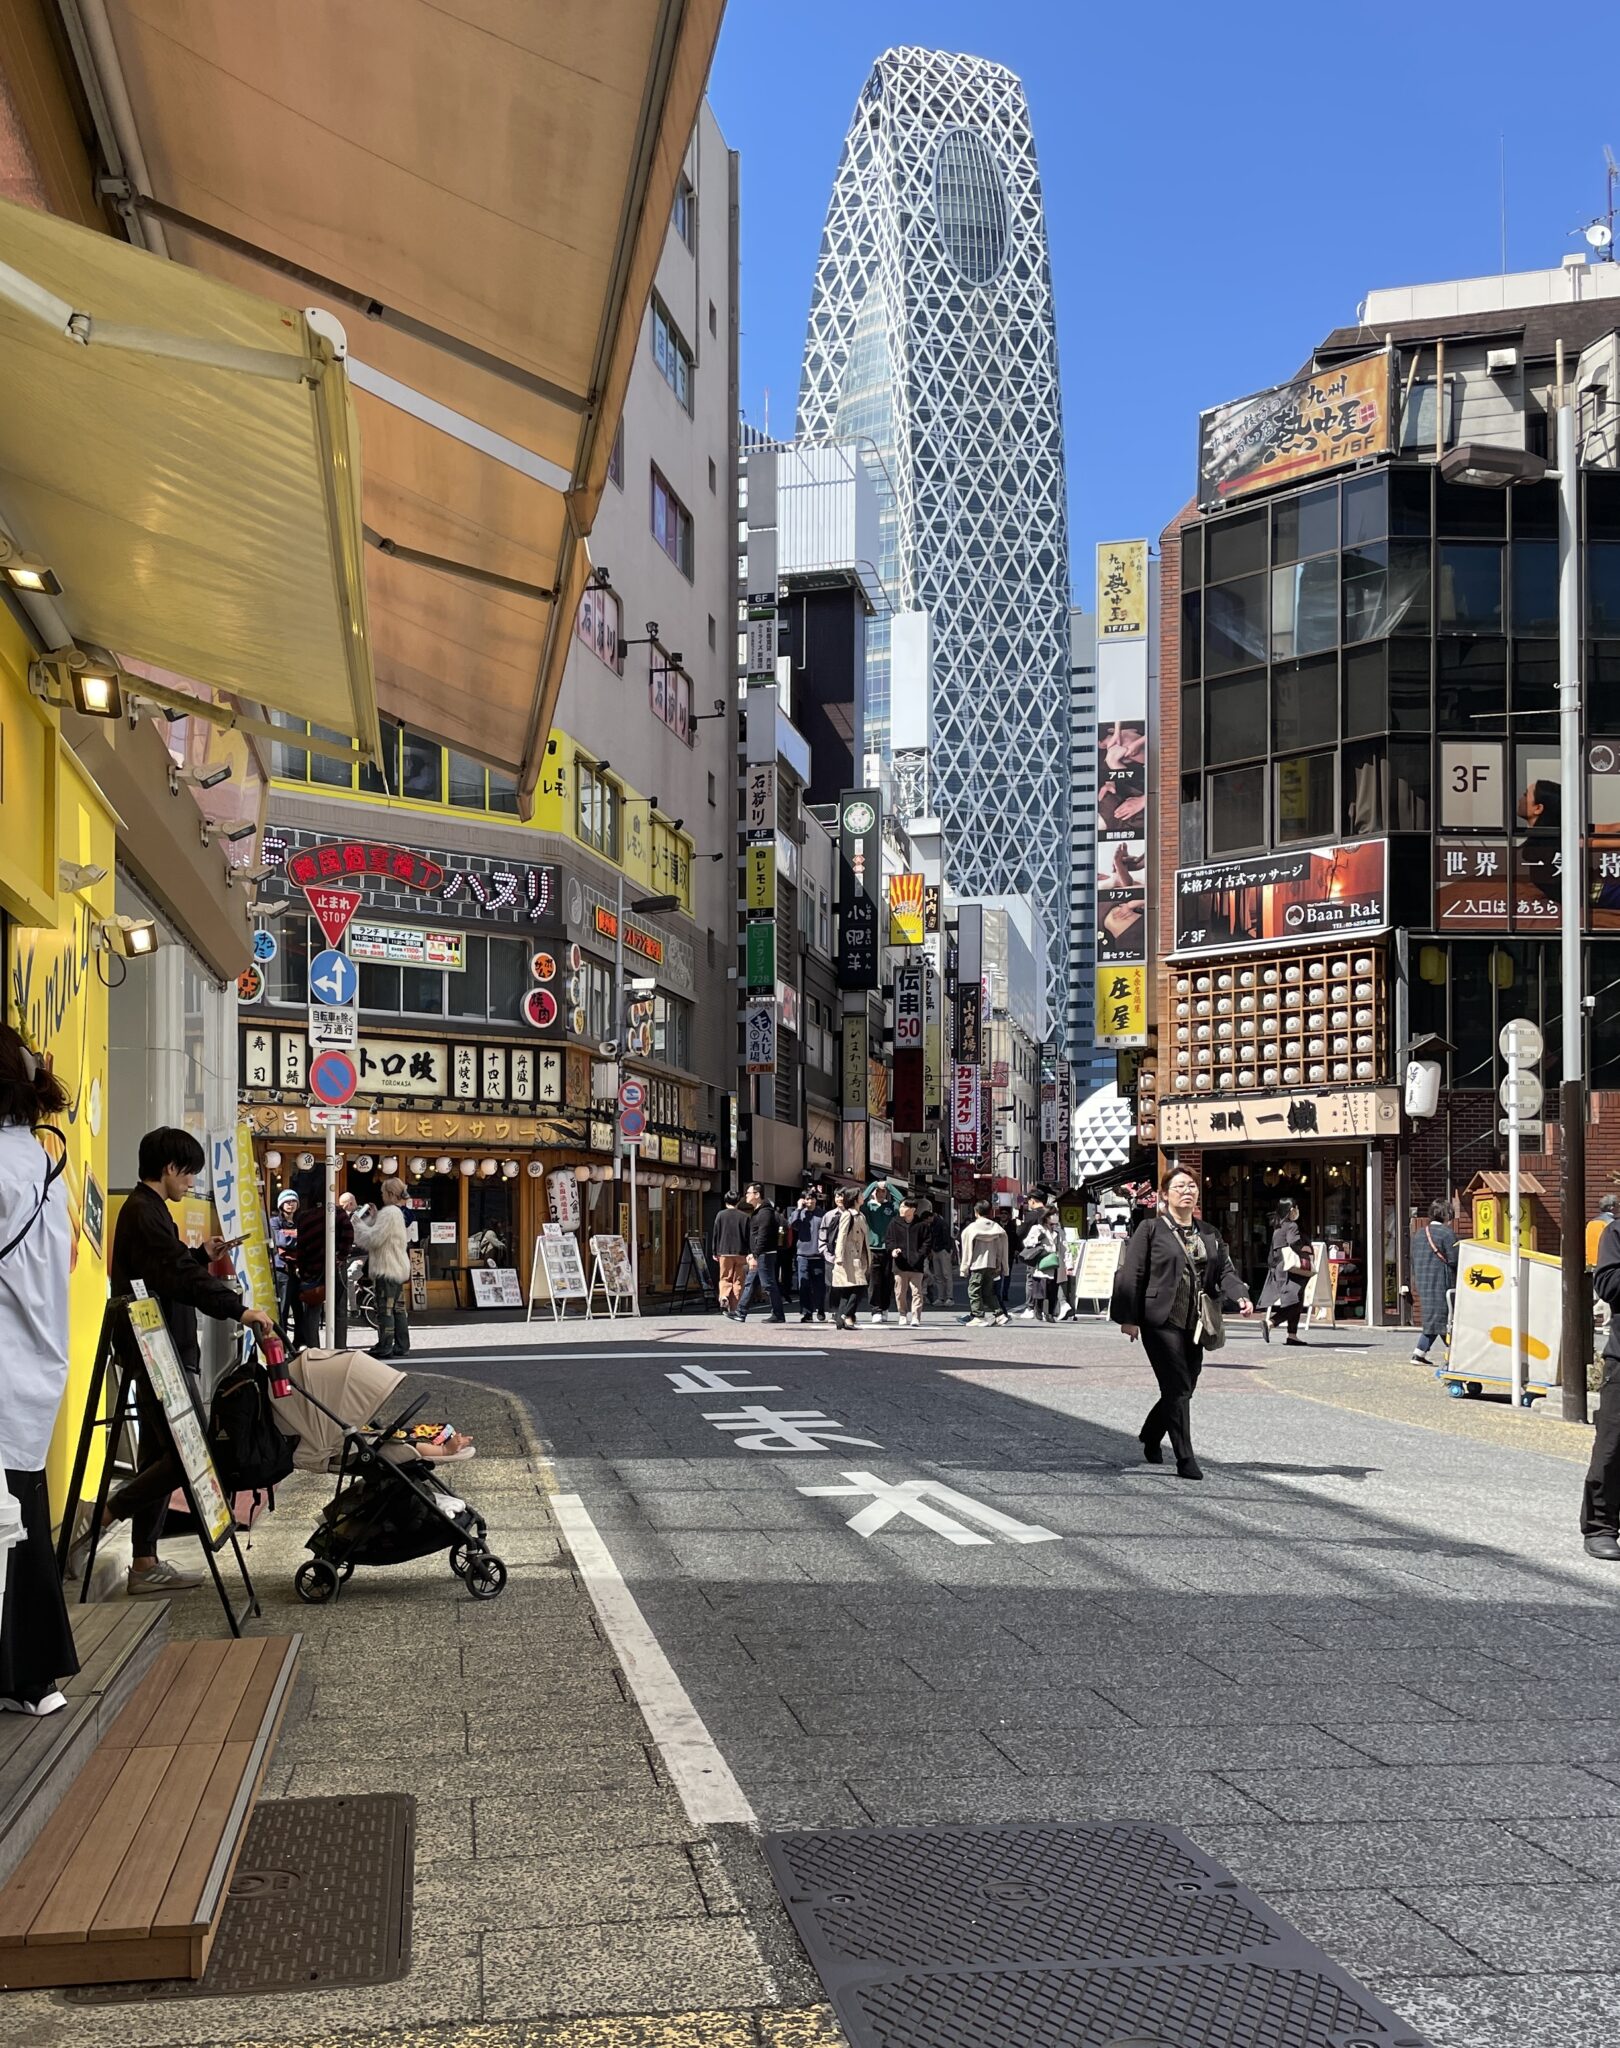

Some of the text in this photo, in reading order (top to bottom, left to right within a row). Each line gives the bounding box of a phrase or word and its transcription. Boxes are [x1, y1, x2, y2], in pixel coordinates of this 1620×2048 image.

[1307, 374, 1347, 407] 九州
[755, 594, 768, 603] 6F
[1109, 771, 1134, 780] アロマ
[1452, 766, 1490, 792] 3F
[754, 830, 767, 838] 4F
[1180, 864, 1304, 894] 本格タイ古式マッサージ
[316, 896, 350, 909] 止まれ
[443, 870, 548, 919] ハヌリ
[1109, 891, 1132, 899] リフレ
[322, 911, 348, 924] STOP
[1307, 900, 1380, 923] Baan Rak
[1464, 900, 1559, 914] 入口は あちら
[360, 927, 380, 936] ランチ
[394, 931, 420, 940] ディナー
[846, 904, 865, 971] 小肥羊
[1190, 929, 1206, 944] 3F
[753, 976, 769, 984] 728
[899, 969, 919, 1015] 伝串
[531, 992, 550, 1023] 焼肉
[1109, 976, 1131, 1031] 庄屋
[312, 1011, 354, 1024] 自転車を除く
[898, 1018, 920, 1037] 50
[312, 1024, 354, 1036] 一方通行
[754, 1014, 771, 1062] もんじゃ
[252, 1035, 266, 1082] 寿司
[286, 1038, 299, 1085] トロ鯖
[487, 1053, 499, 1096] 十四代
[543, 1055, 555, 1096] 和牛
[957, 1066, 972, 1125] カラオケ
[1058, 1062, 1069, 1142] ヨドバシカメラ
[957, 1143, 973, 1151] OK
[664, 1365, 1063, 1545] 止まれ
